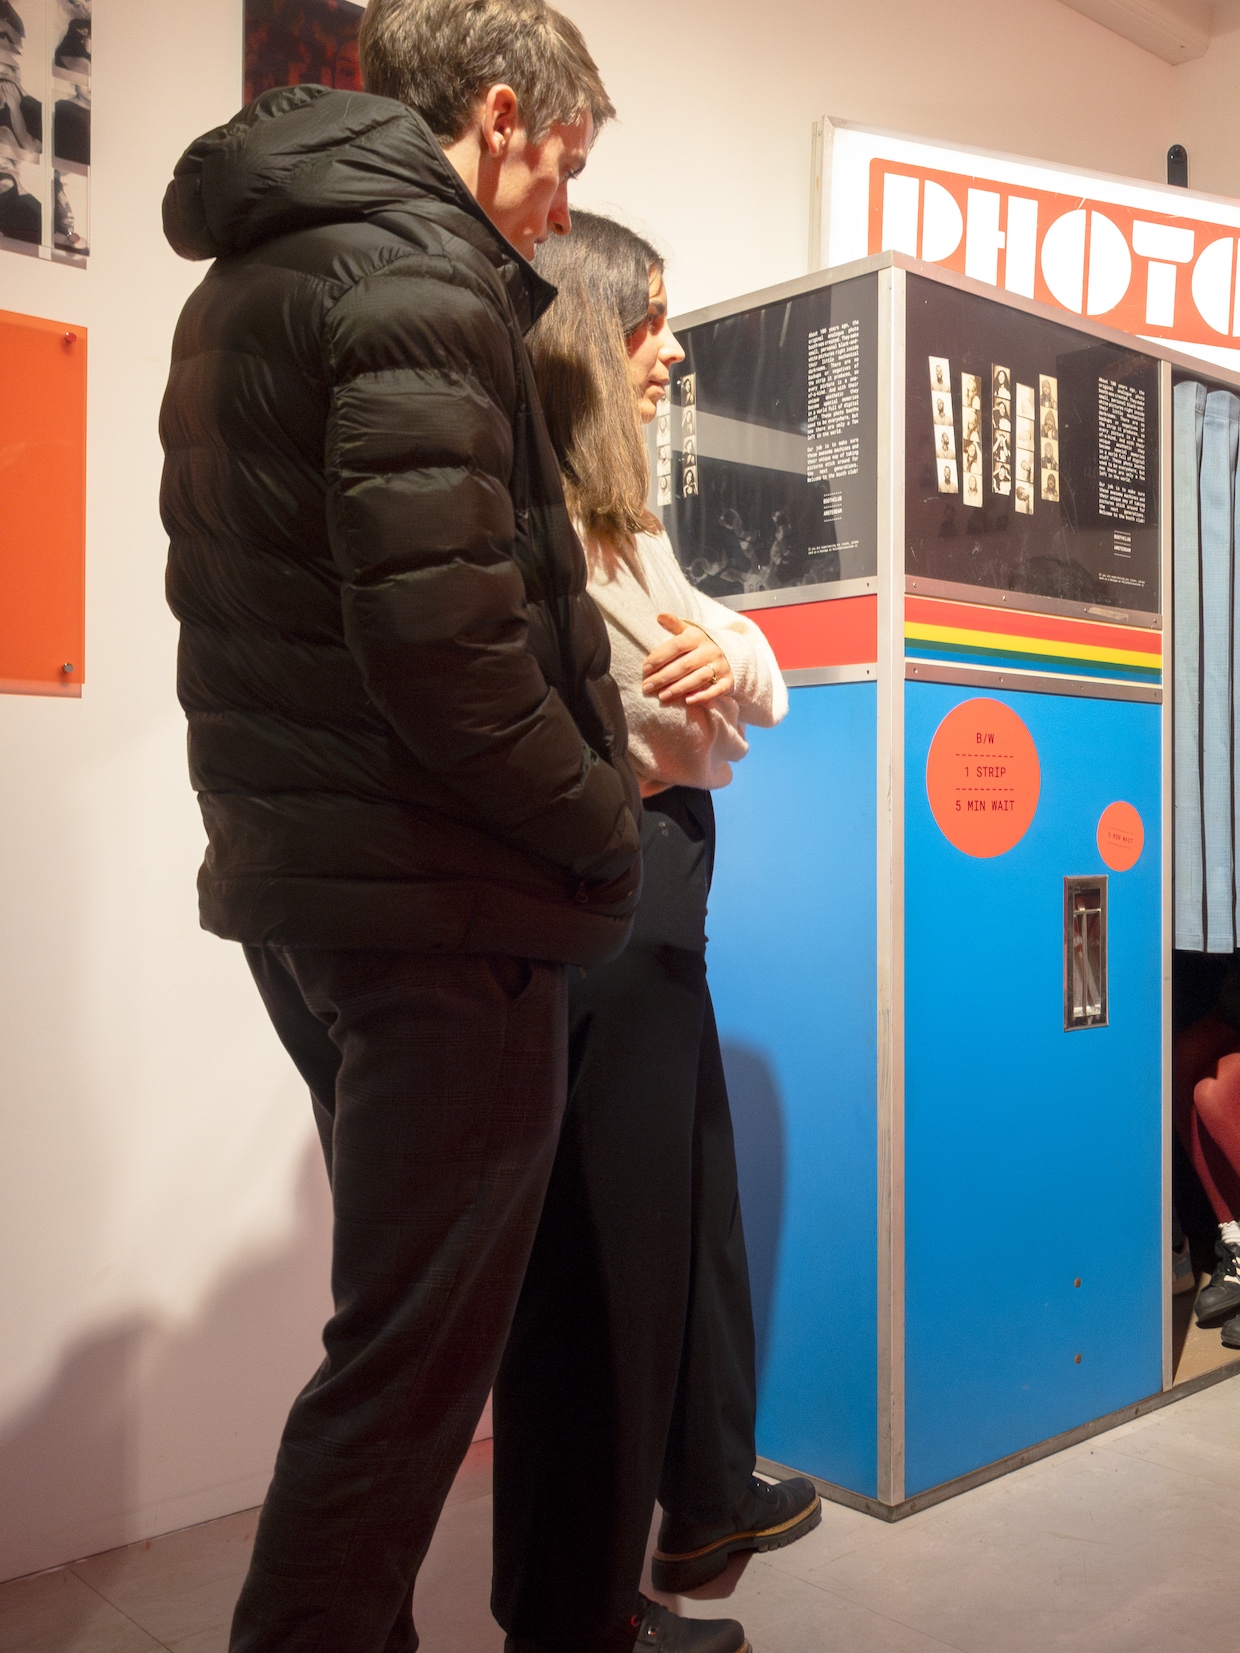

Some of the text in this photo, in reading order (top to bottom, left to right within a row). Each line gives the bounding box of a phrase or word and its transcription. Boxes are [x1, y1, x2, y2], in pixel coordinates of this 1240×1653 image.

[976, 732, 995, 744] B/W
[965, 767, 1007, 778] 1 STRIP
[955, 800, 1015, 812] 5 MIN WAIT
